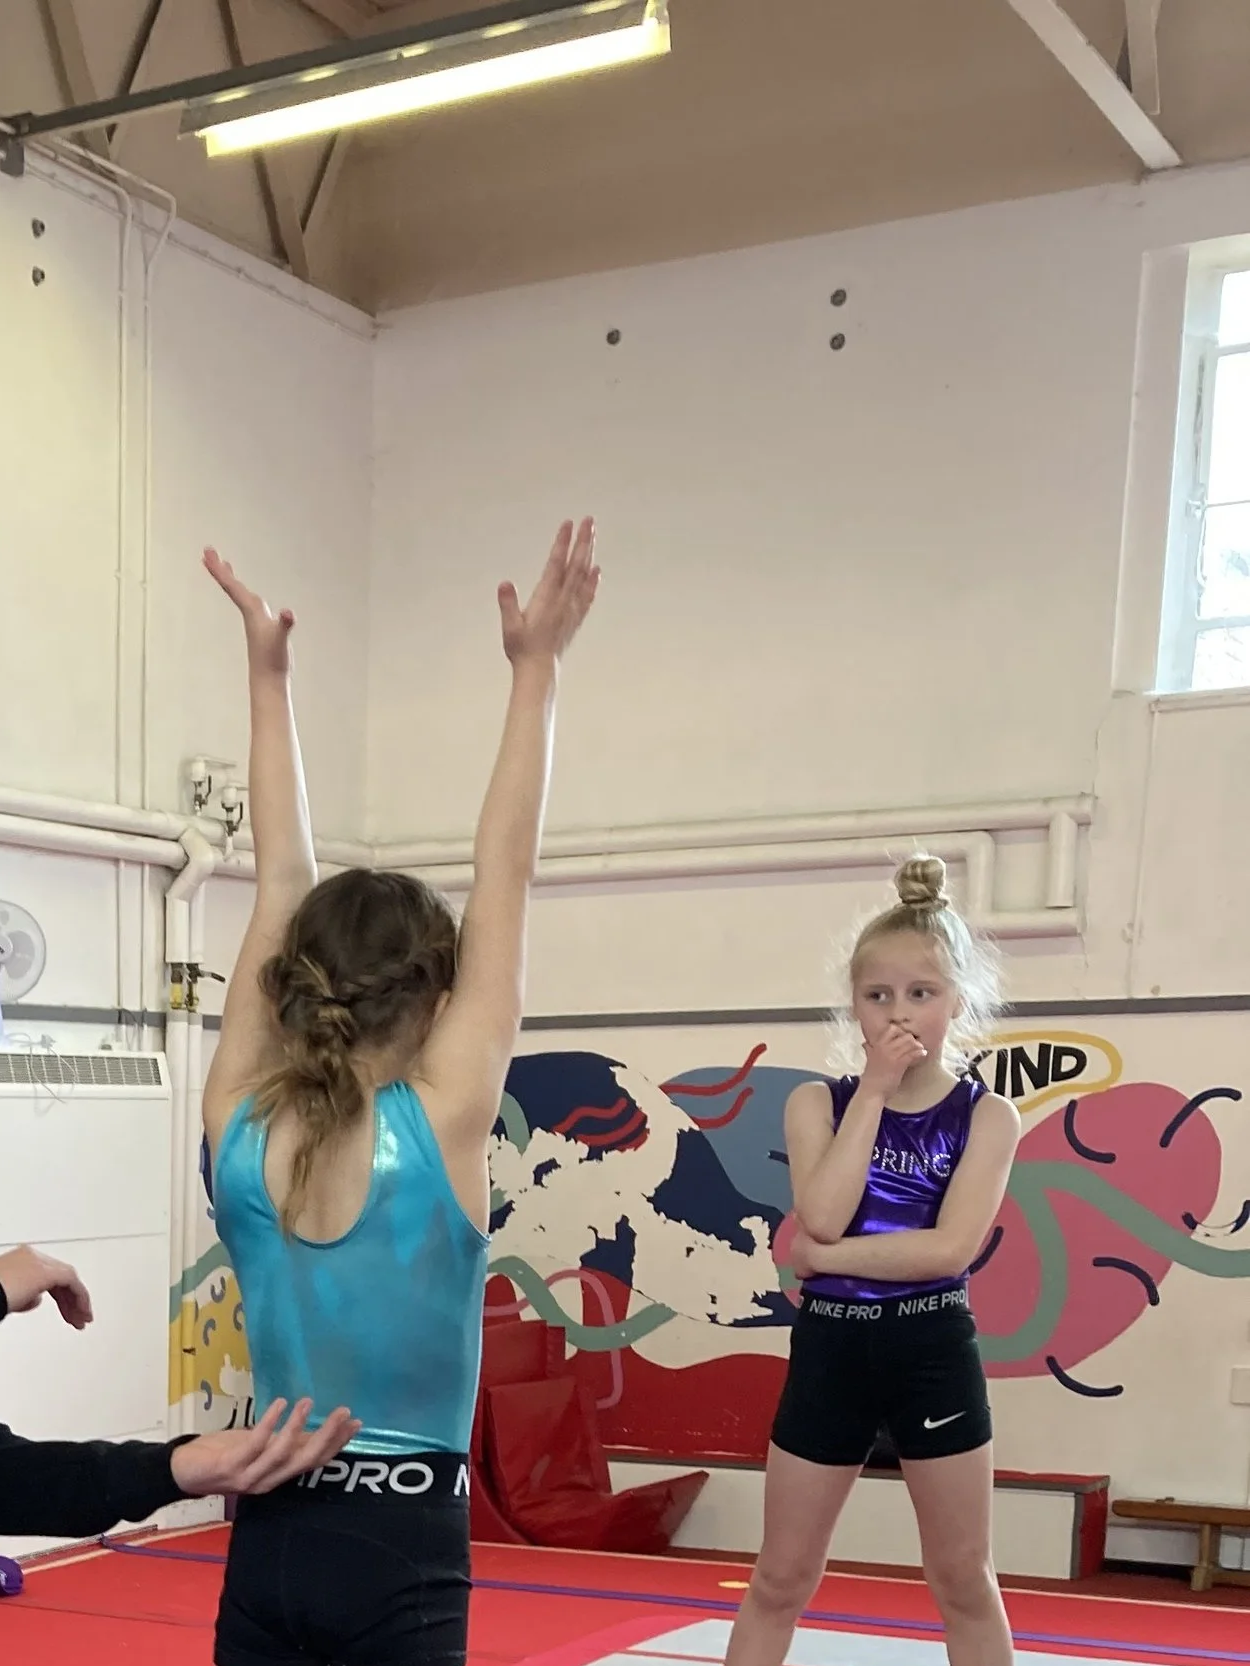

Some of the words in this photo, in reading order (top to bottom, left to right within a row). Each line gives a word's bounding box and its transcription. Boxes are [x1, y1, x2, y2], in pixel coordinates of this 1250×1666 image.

[809, 1299, 845, 1318] NIKE
[846, 1304, 882, 1320] PRO
[897, 1295, 939, 1316] NIKE
[941, 1289, 966, 1309] PRO
[306, 1459, 434, 1495] PRO
